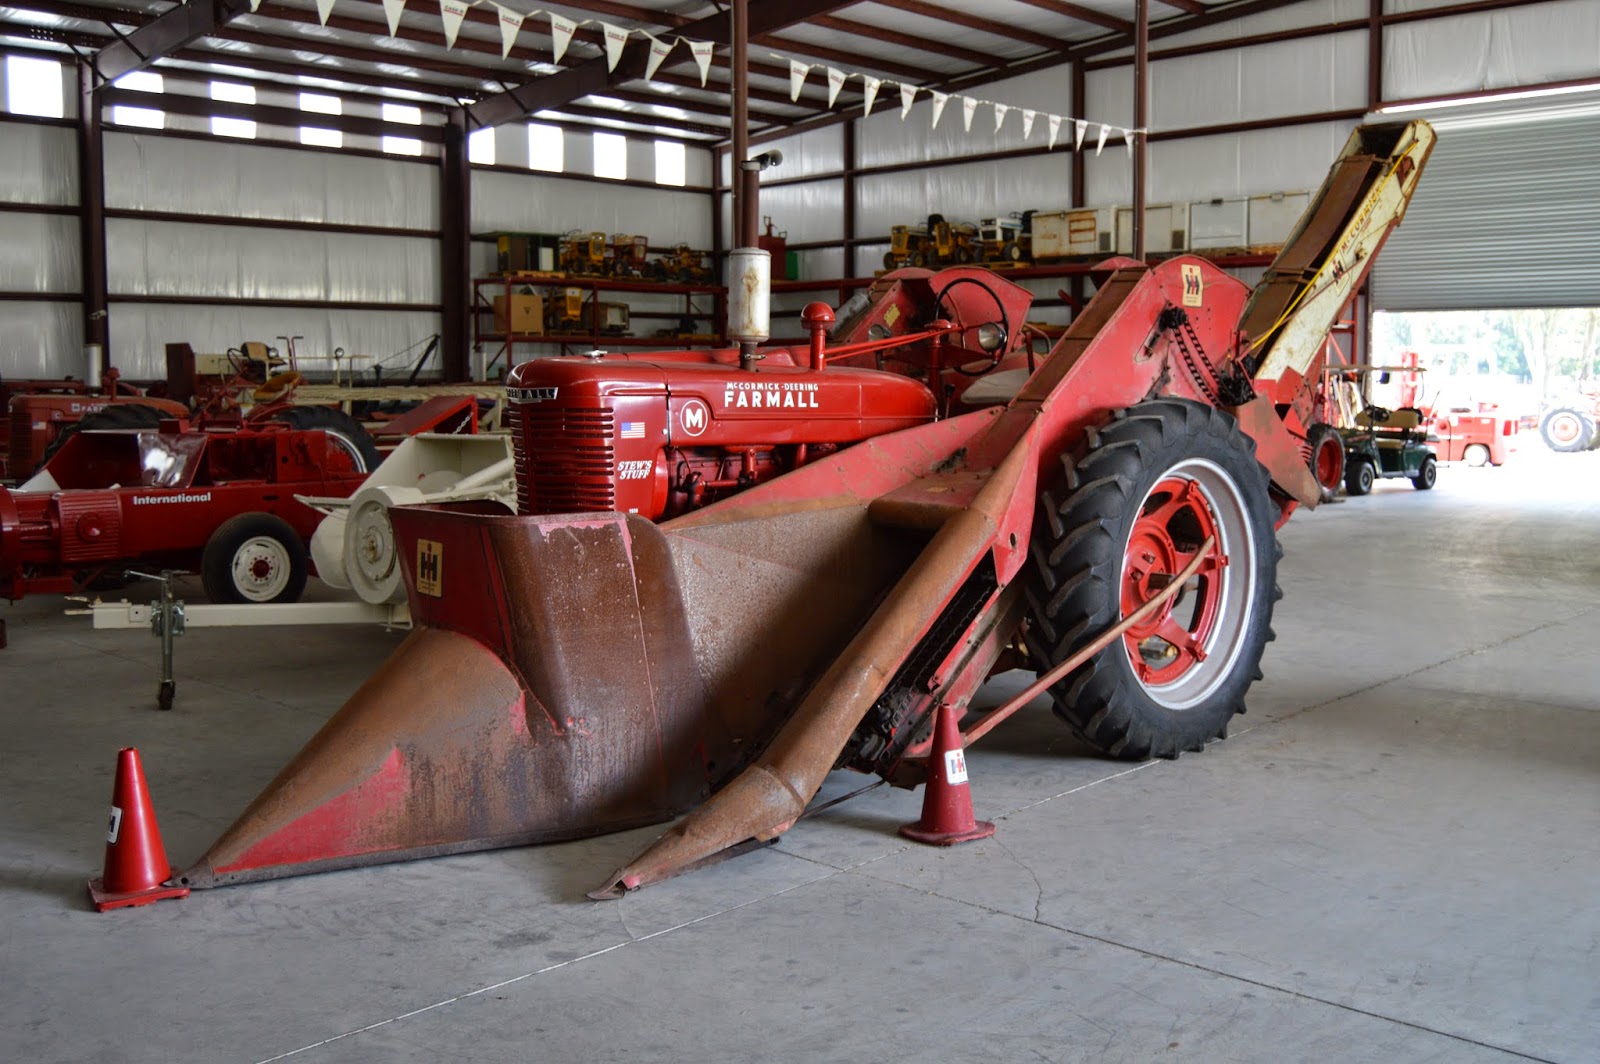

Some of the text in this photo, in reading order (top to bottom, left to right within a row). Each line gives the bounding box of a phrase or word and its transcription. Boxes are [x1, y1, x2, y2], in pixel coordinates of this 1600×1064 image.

[724, 391, 819, 408] FARMALL
[685, 408, 703, 428] M
[618, 460, 652, 470] STEW'S
[619, 470, 650, 479] STUFF
[133, 491, 212, 505] International
